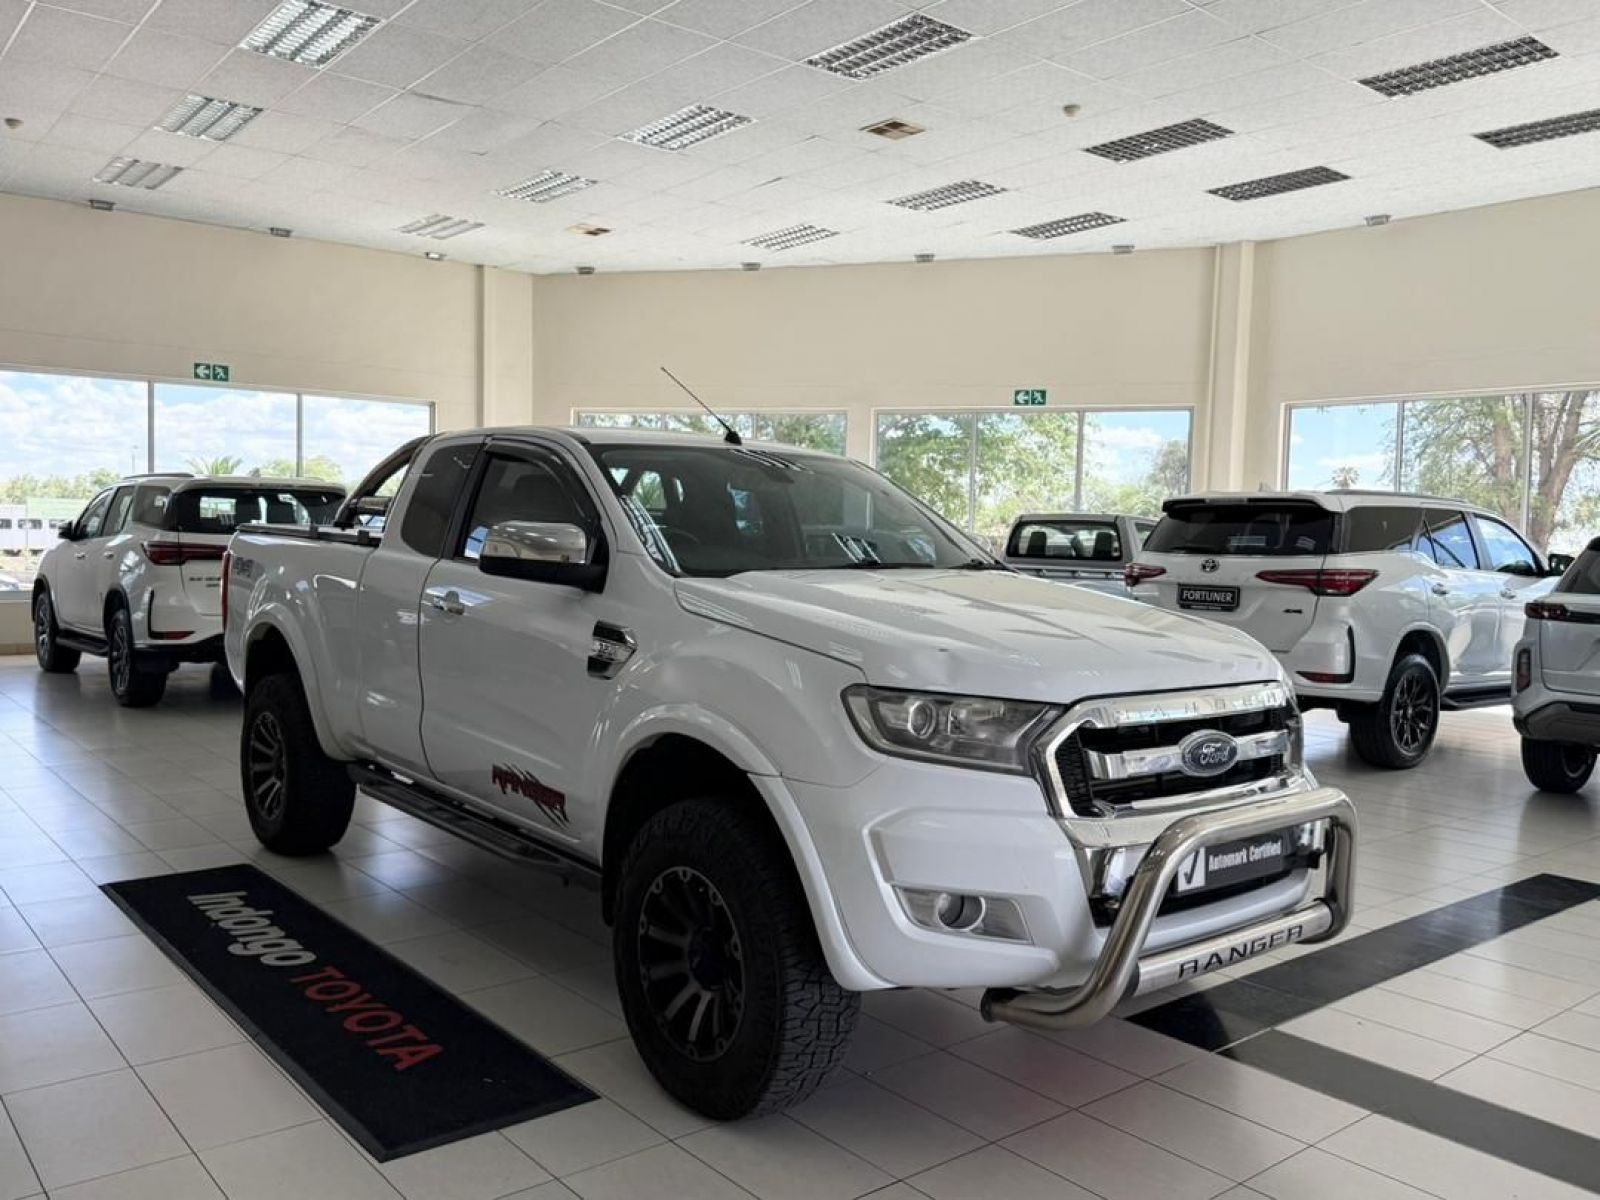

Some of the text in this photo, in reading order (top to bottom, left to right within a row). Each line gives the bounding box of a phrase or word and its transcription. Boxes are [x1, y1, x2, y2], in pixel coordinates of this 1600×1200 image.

[1182, 590, 1234, 602] FORTUNER
[1207, 840, 1282, 872] Automark Certified
[1178, 924, 1303, 978] RANGER
[187, 891, 443, 1071] Indongo TOYOTA
